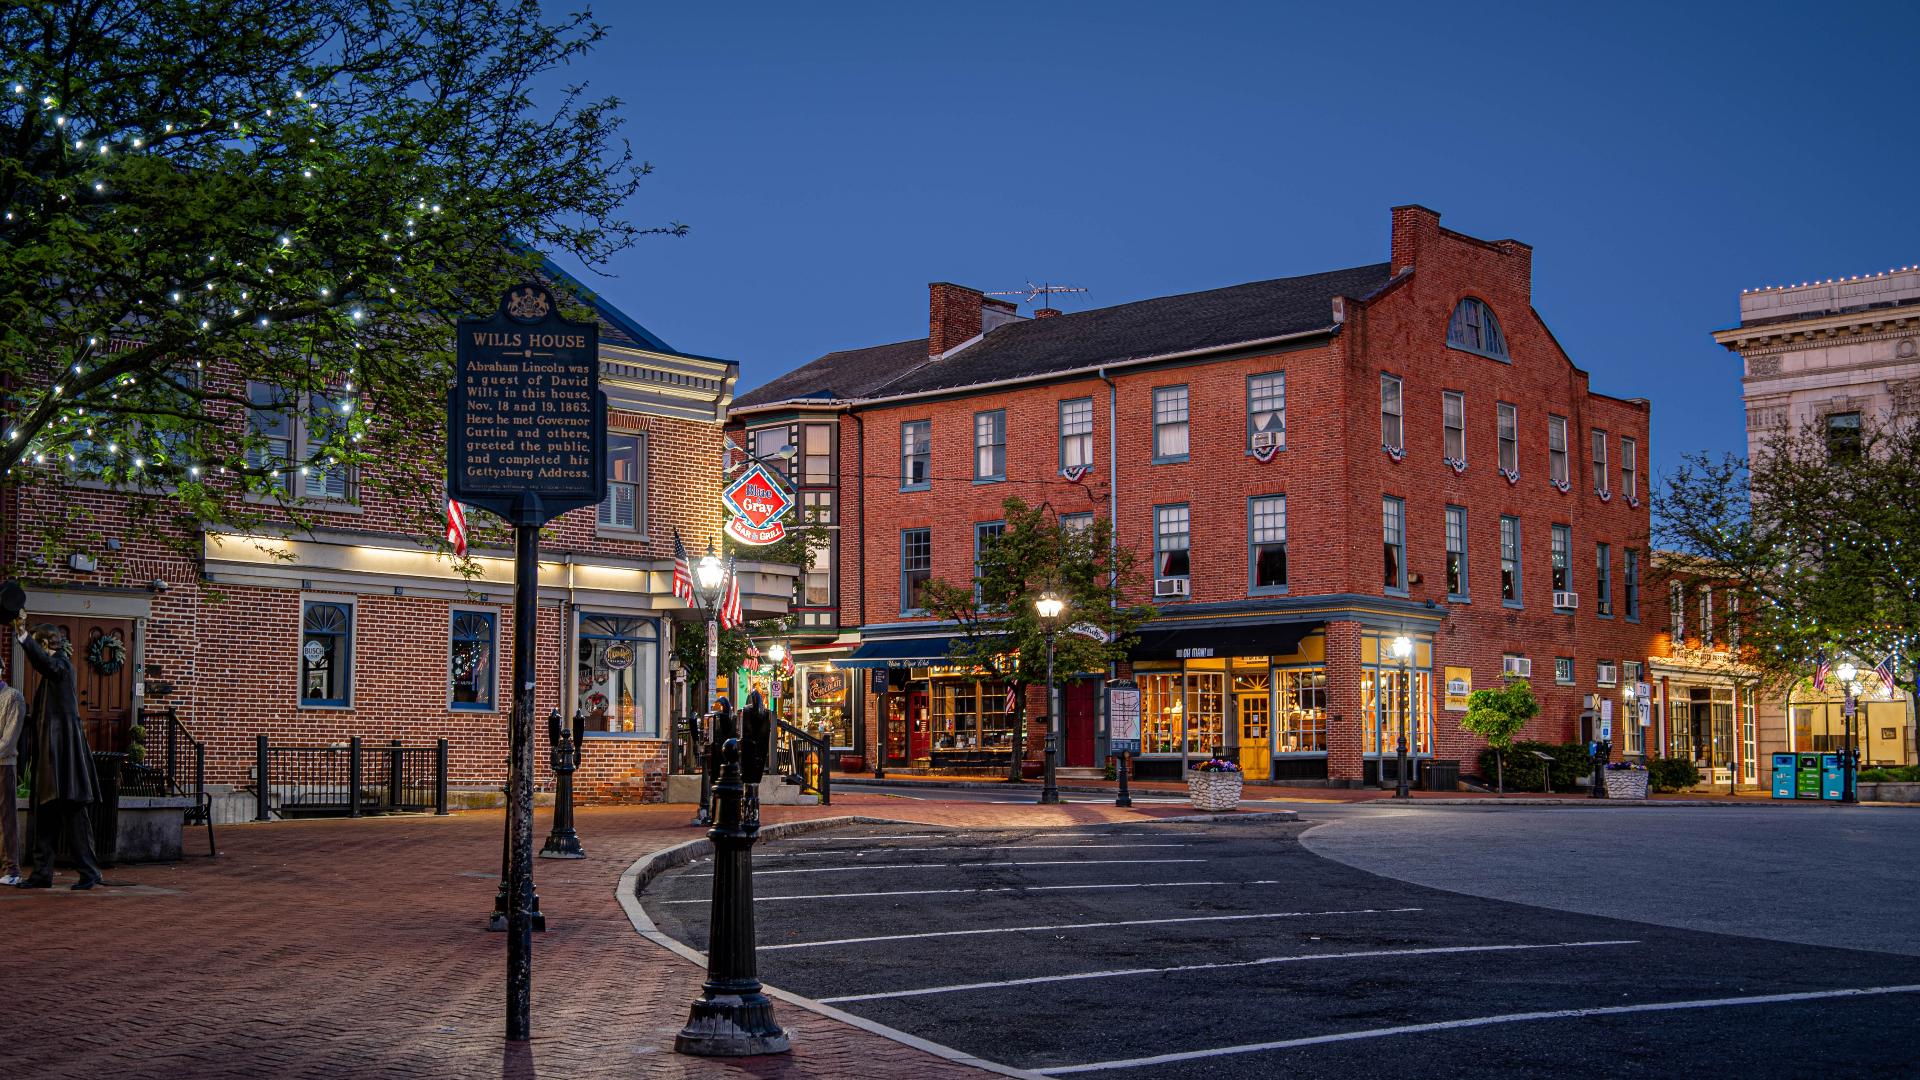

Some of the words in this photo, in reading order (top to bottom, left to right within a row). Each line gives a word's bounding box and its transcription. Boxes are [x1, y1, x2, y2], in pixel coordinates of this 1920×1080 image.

[472, 332, 522, 347] WILLS
[529, 334, 586, 348] HOUSE
[466, 361, 518, 372] Abraham
[522, 362, 565, 373] Lincoln
[482, 376, 519, 387] guest
[527, 376, 543, 385] of
[551, 376, 589, 387] David
[467, 387, 499, 398] Wills
[505, 388, 517, 398] in
[522, 388, 546, 399] this
[551, 389, 591, 400] house,
[467, 401, 493, 411] Nov.
[498, 401, 509, 411] 18
[513, 402, 536, 412] and
[560, 402, 590, 413] 1863.
[466, 413, 494, 424] Here
[496, 414, 510, 425] he
[513, 416, 533, 425] met
[537, 416, 590, 426] Governor
[466, 427, 508, 437] Curtin
[516, 428, 540, 438] and
[547, 429, 590, 440] others,
[466, 441, 514, 452] greeted
[520, 441, 541, 451] the
[548, 442, 590, 453] public,
[467, 454, 490, 464] and
[499, 454, 561, 466] completed
[570, 455, 589, 465] his
[467, 467, 534, 480] Gettysburg
[538, 468, 590, 478] Address.
[745, 484, 773, 499] Blue
[742, 498, 774, 516] Gray
[304, 647, 324, 655] BUSCH
[1640, 685, 1647, 695] TO
[1639, 703, 1649, 720] 97
